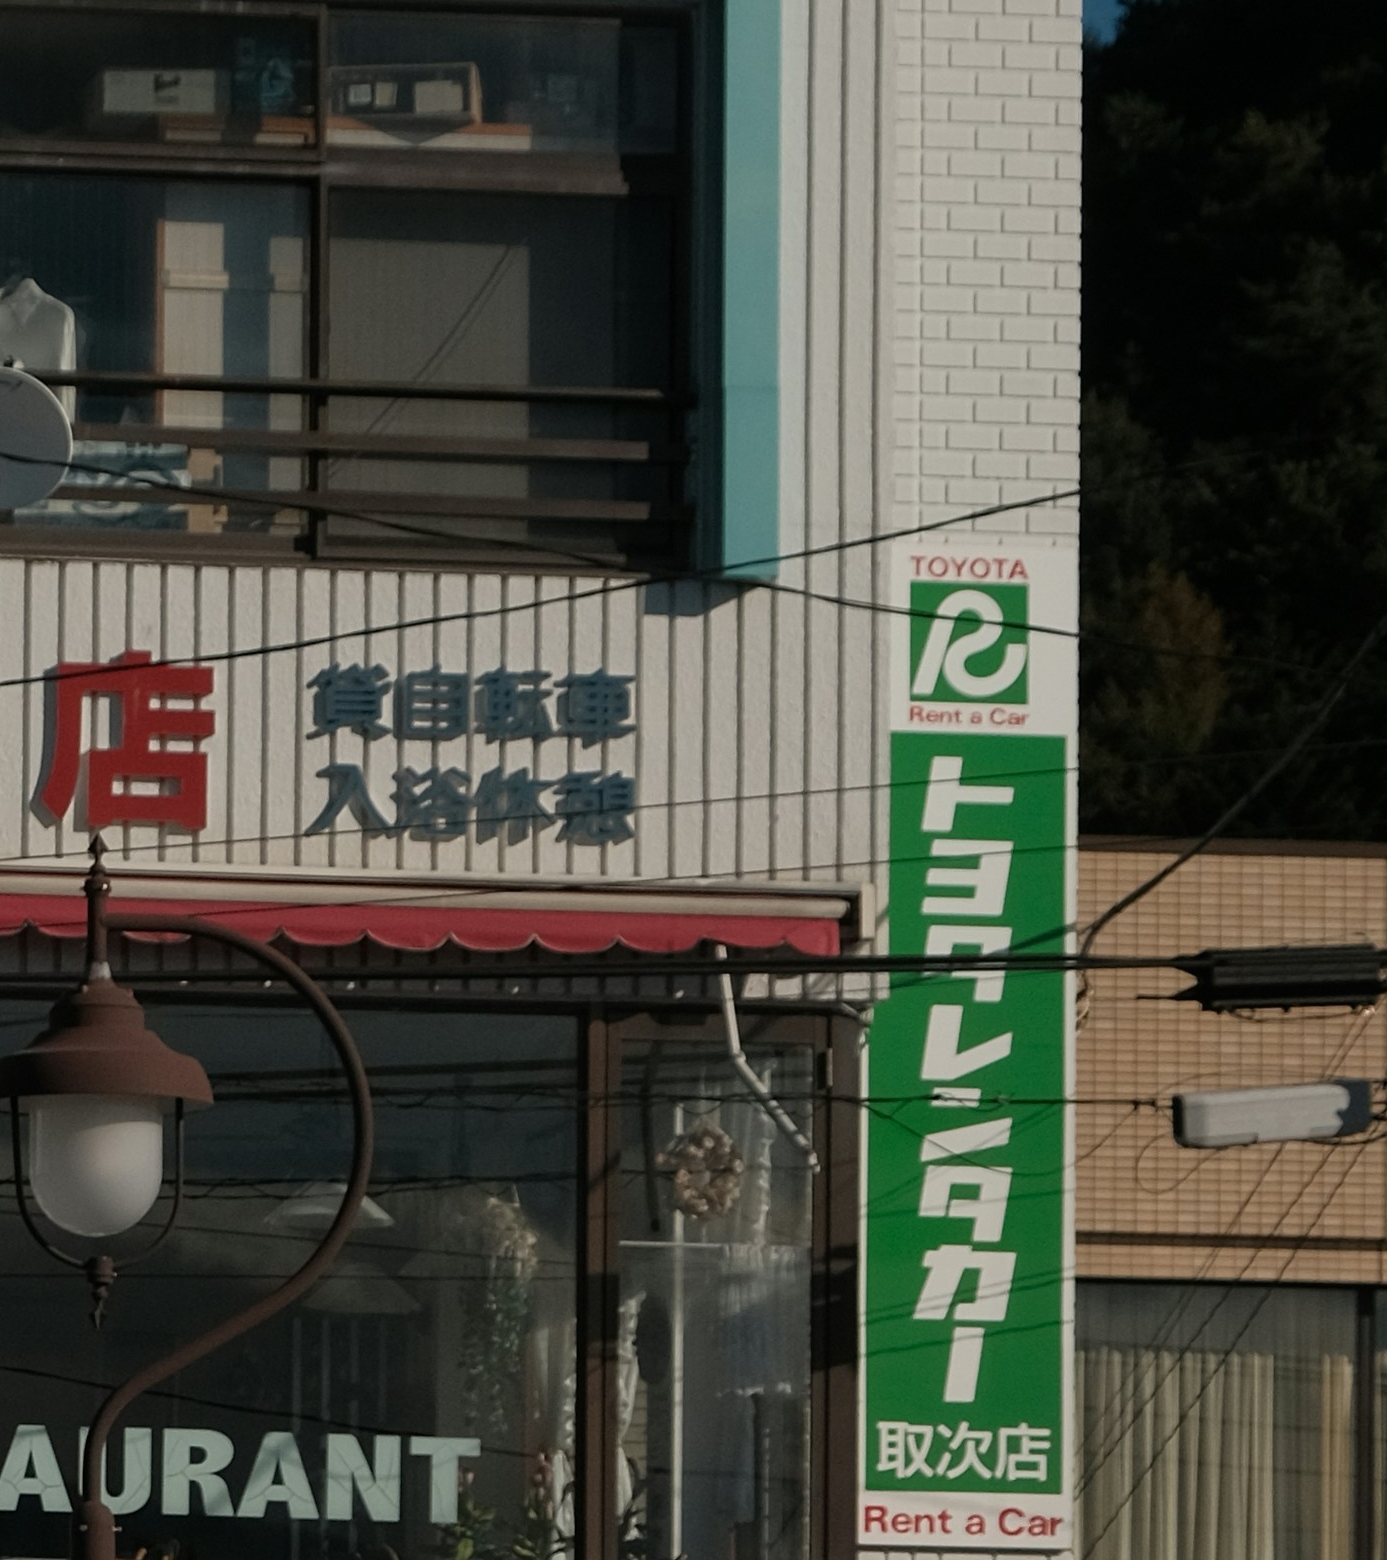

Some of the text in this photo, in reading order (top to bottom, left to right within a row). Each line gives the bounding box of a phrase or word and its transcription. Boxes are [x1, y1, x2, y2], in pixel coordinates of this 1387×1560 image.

[910, 555, 1029, 580] TOYOTA
[306, 662, 638, 749] 貸自転車
[909, 704, 1029, 727] Rent a Car
[304, 763, 636, 847] 入浴休憩
[913, 755, 1018, 1403] トヨタレンタカー
[876, 1420, 1051, 1482] 取次店
[863, 1505, 1064, 1538] Rent a Car
